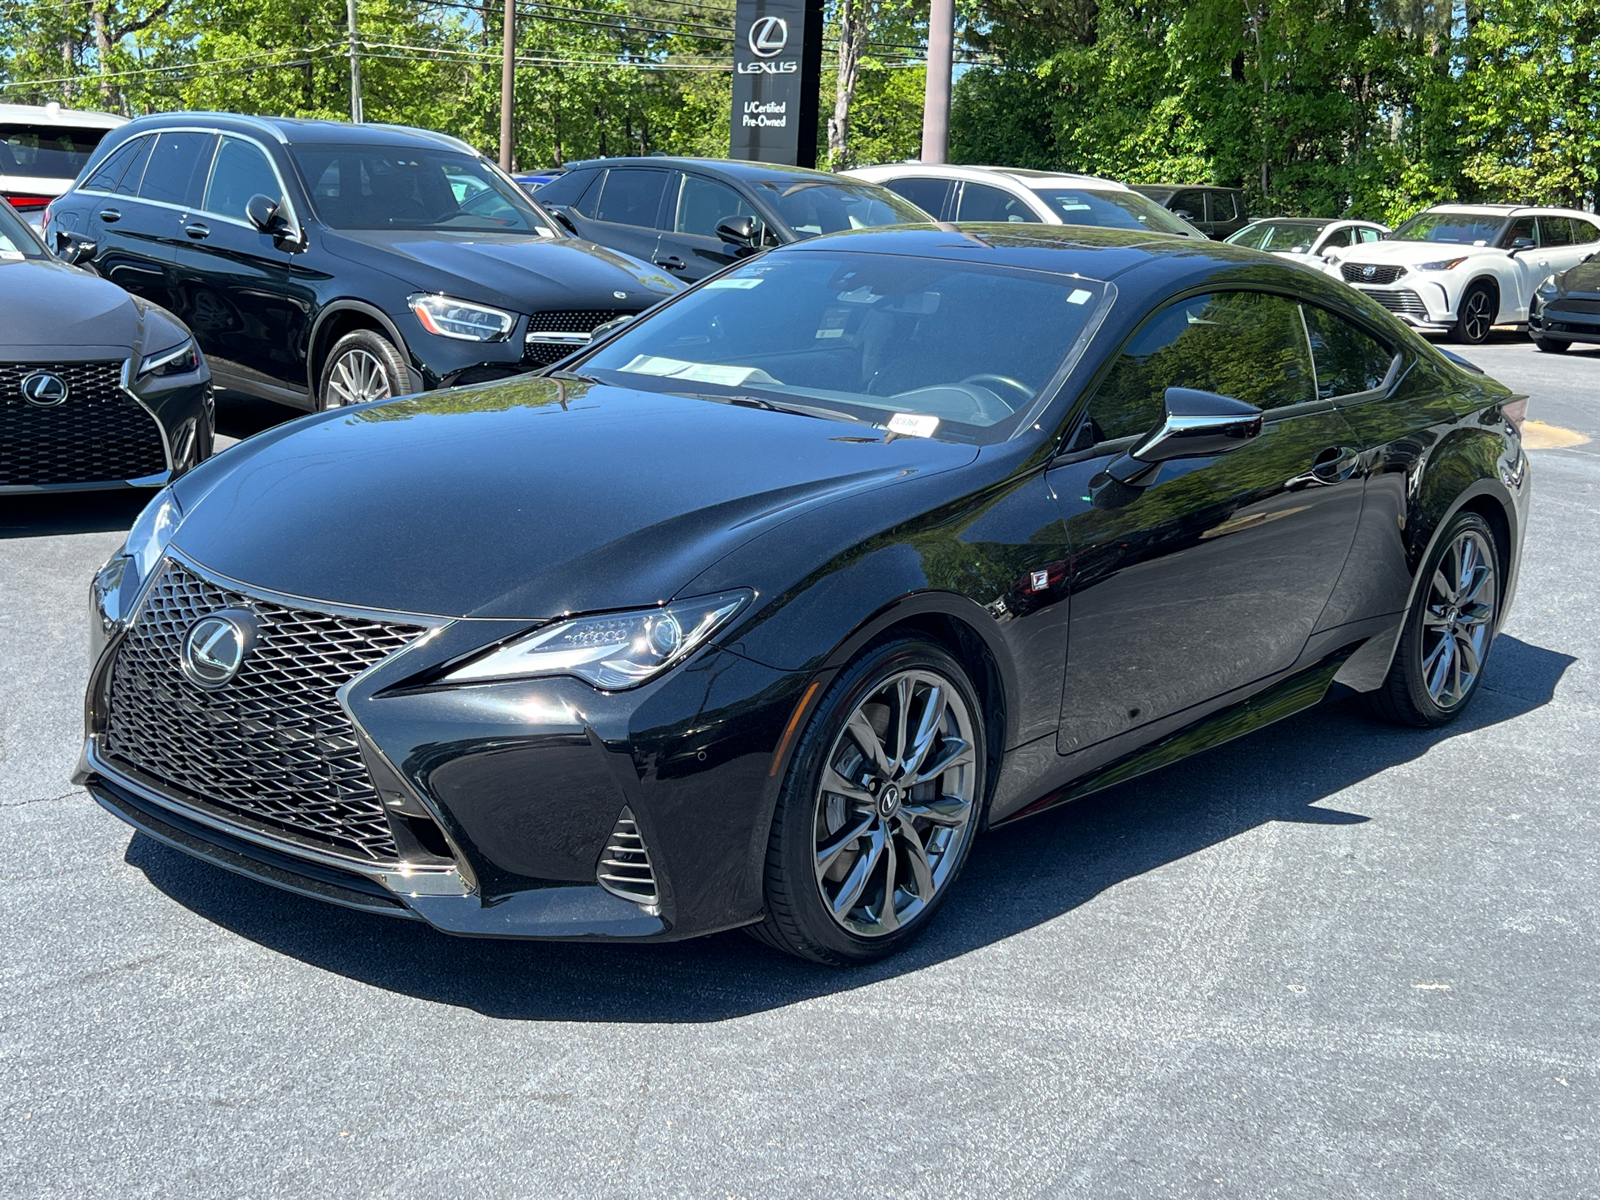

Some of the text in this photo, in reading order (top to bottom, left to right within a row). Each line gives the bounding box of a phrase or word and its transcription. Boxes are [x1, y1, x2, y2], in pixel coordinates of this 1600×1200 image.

[737, 61, 798, 74] LEXUS
[744, 101, 786, 114] L/Certified
[742, 115, 786, 127] Pre-Owned
